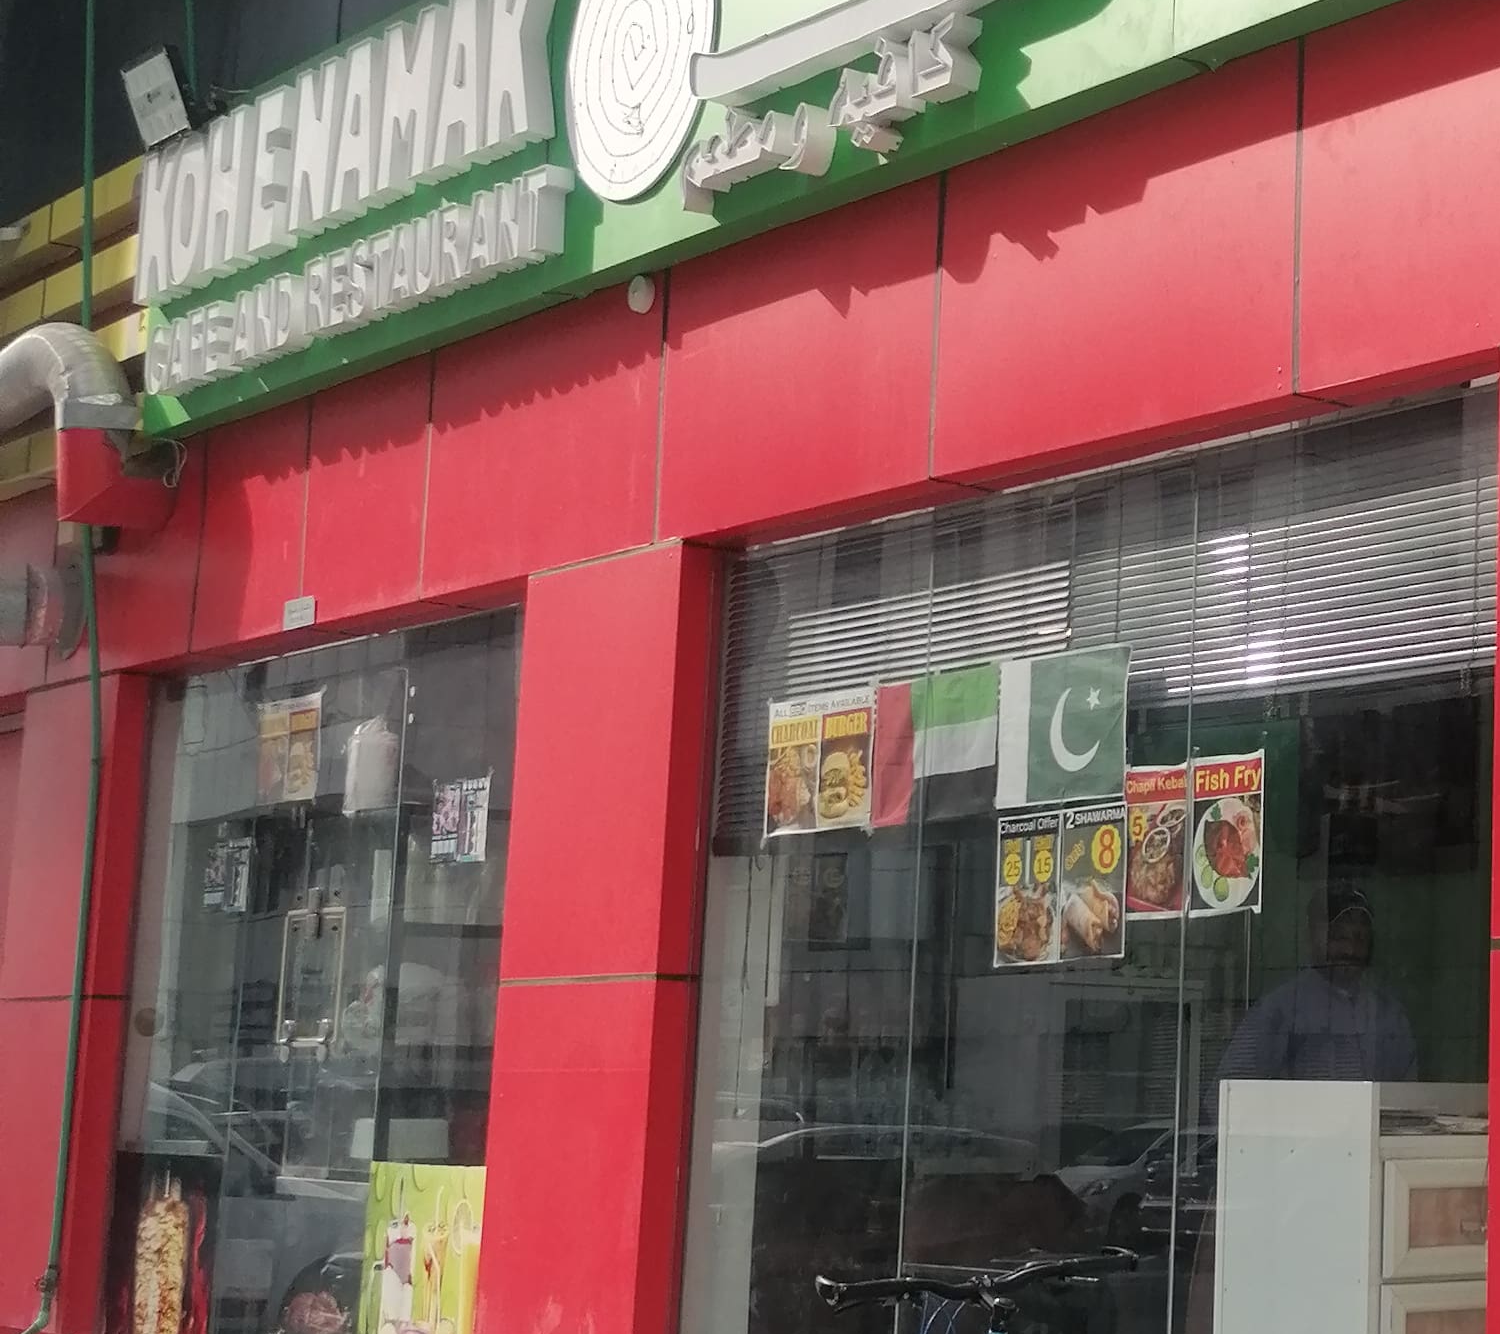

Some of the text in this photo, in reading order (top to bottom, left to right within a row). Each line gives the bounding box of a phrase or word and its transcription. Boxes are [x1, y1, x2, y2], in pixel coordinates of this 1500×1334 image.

[144, 164, 575, 395] CAFE AND RESTAURANT
[1195, 765, 1261, 793] Fish Fry
[1000, 819, 1037, 835] Charcoal
[1065, 806, 1126, 830] 2 SHAWARMA
[1098, 828, 1115, 869] 8
[1006, 860, 1020, 877] 25
[1036, 857, 1051, 874] 15
